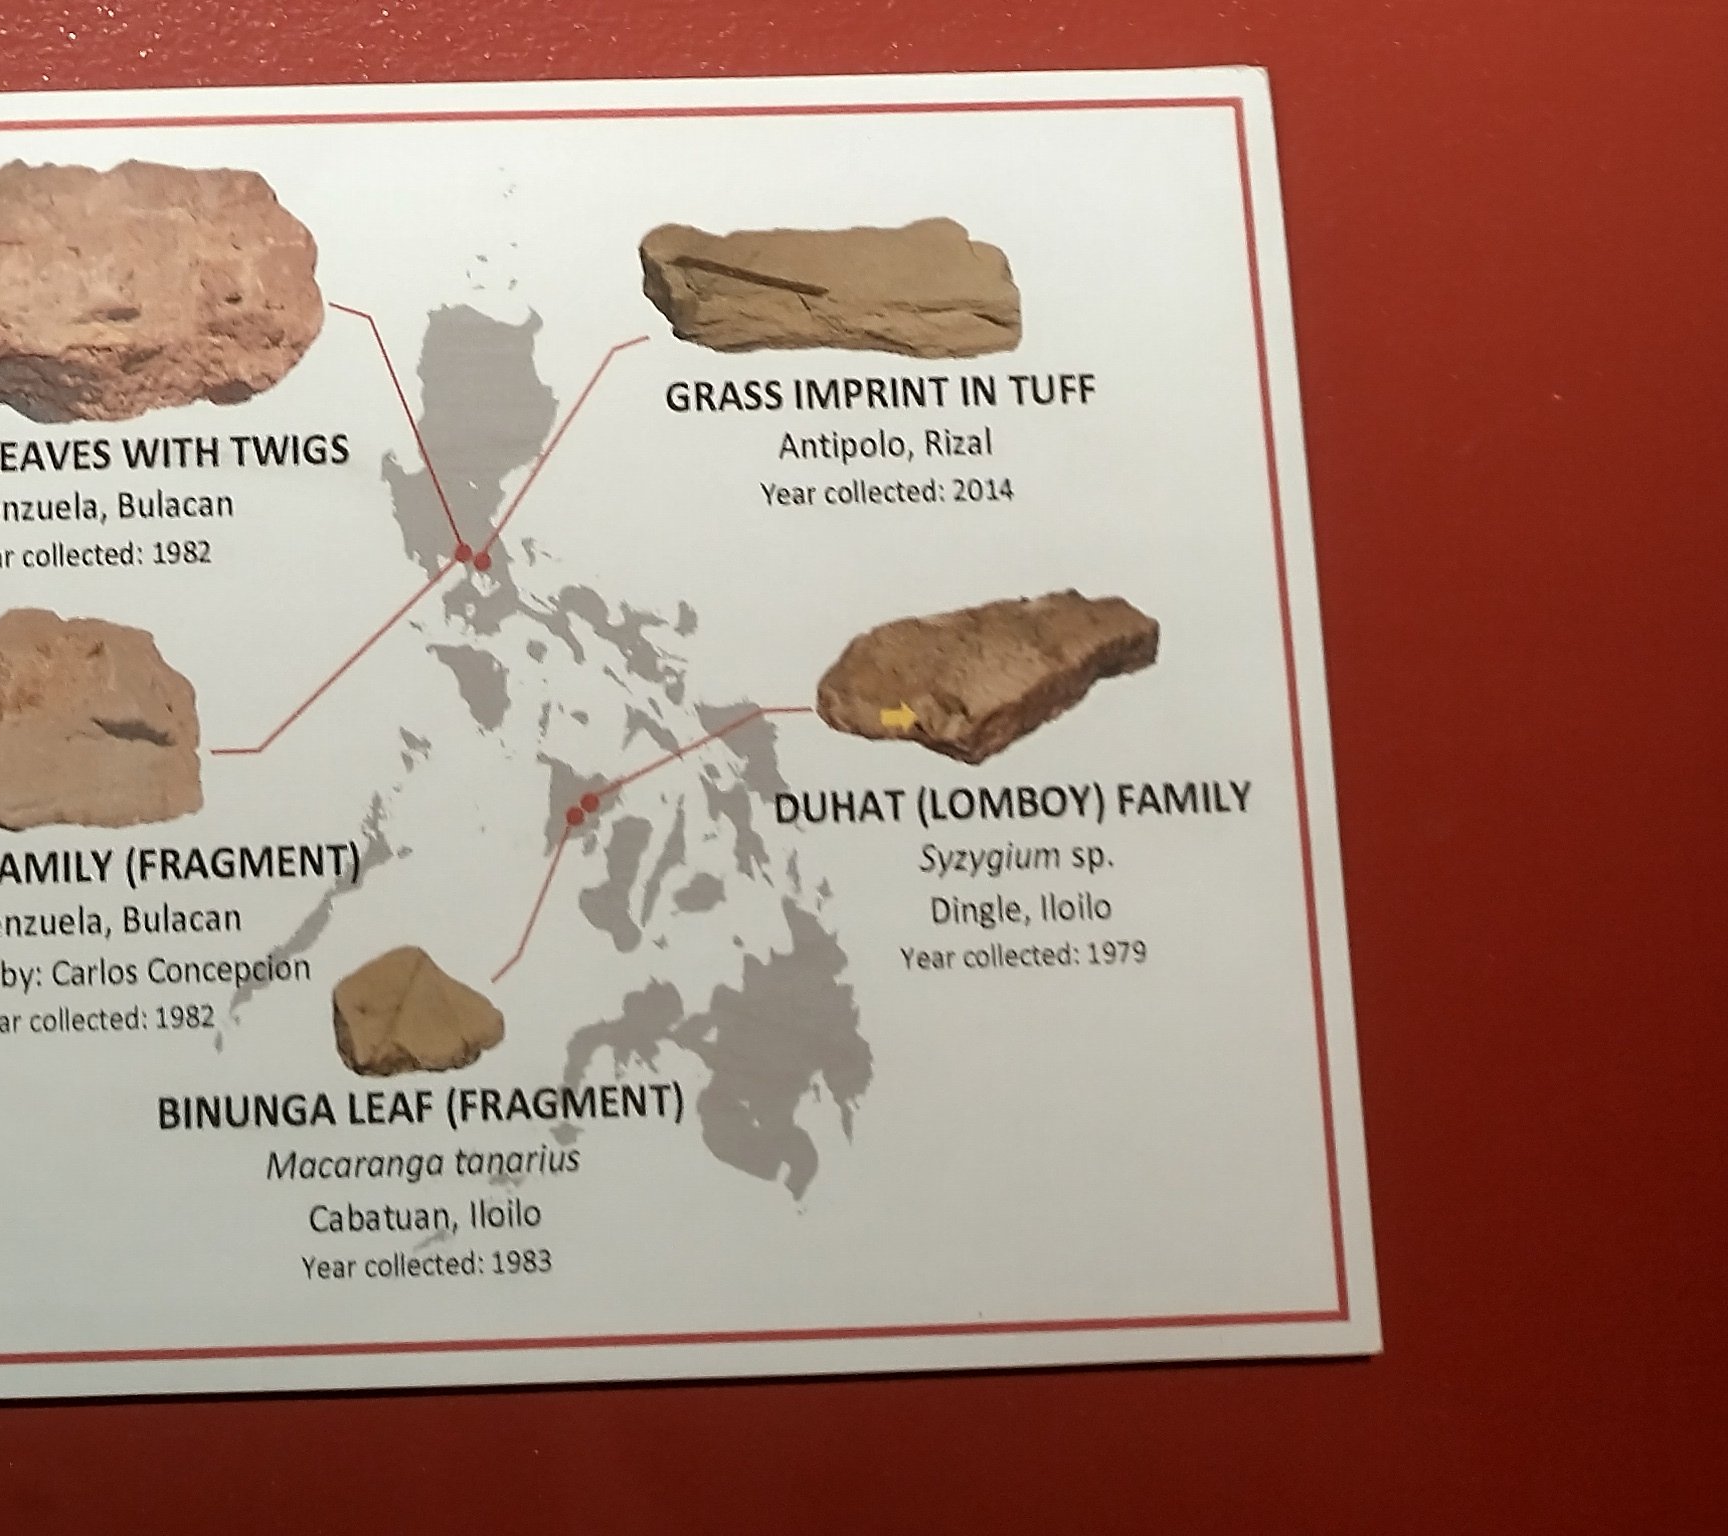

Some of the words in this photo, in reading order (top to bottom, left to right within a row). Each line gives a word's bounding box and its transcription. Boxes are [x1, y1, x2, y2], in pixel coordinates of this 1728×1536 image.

[666, 380, 783, 412] GRASS
[794, 376, 949, 410] IMPRINT
[961, 375, 996, 407] IN
[1008, 374, 1095, 405] TUFF
[122, 437, 219, 469] WITH
[229, 434, 350, 467] TWIGS
[779, 429, 914, 465] Antipolo,
[925, 426, 992, 456] Rizal
[118, 489, 233, 519] Bulacan
[760, 482, 816, 505] Year
[824, 479, 944, 504] collected:
[954, 478, 1014, 501] 2014
[22, 541, 143, 568] collected:
[154, 540, 211, 565] 1982
[774, 789, 906, 824] DUHAT
[917, 782, 1105, 829] (LOMBOY)
[1117, 780, 1251, 816] FAMILY
[126, 840, 361, 890] (FRAGMENT)
[919, 842, 1060, 877] Syzygium
[1072, 847, 1113, 874] sp.
[123, 902, 241, 934] Bulacan
[932, 894, 1031, 929] Dingle,
[1041, 892, 1111, 921] Iloilo
[900, 948, 952, 969] Year
[963, 943, 1079, 968] collected:
[1090, 940, 1146, 964] 1979
[1, 960, 42, 995] by:
[52, 957, 138, 987] Carlos
[147, 953, 310, 990] Concepcion
[29, 1005, 147, 1033] collected:
[156, 1004, 215, 1029] 1982
[158, 1092, 337, 1130] BINUNGA
[348, 1090, 433, 1125] LEAF
[446, 1080, 685, 1131] (FRAGMENT)
[266, 1151, 444, 1184] Macaranga
[455, 1144, 580, 1176] tanarius
[309, 1203, 458, 1235] Cabatuan,
[470, 1197, 541, 1229] Iloilo
[301, 1256, 357, 1280] Year
[364, 1250, 484, 1278] collected:
[493, 1248, 552, 1274] 1983
